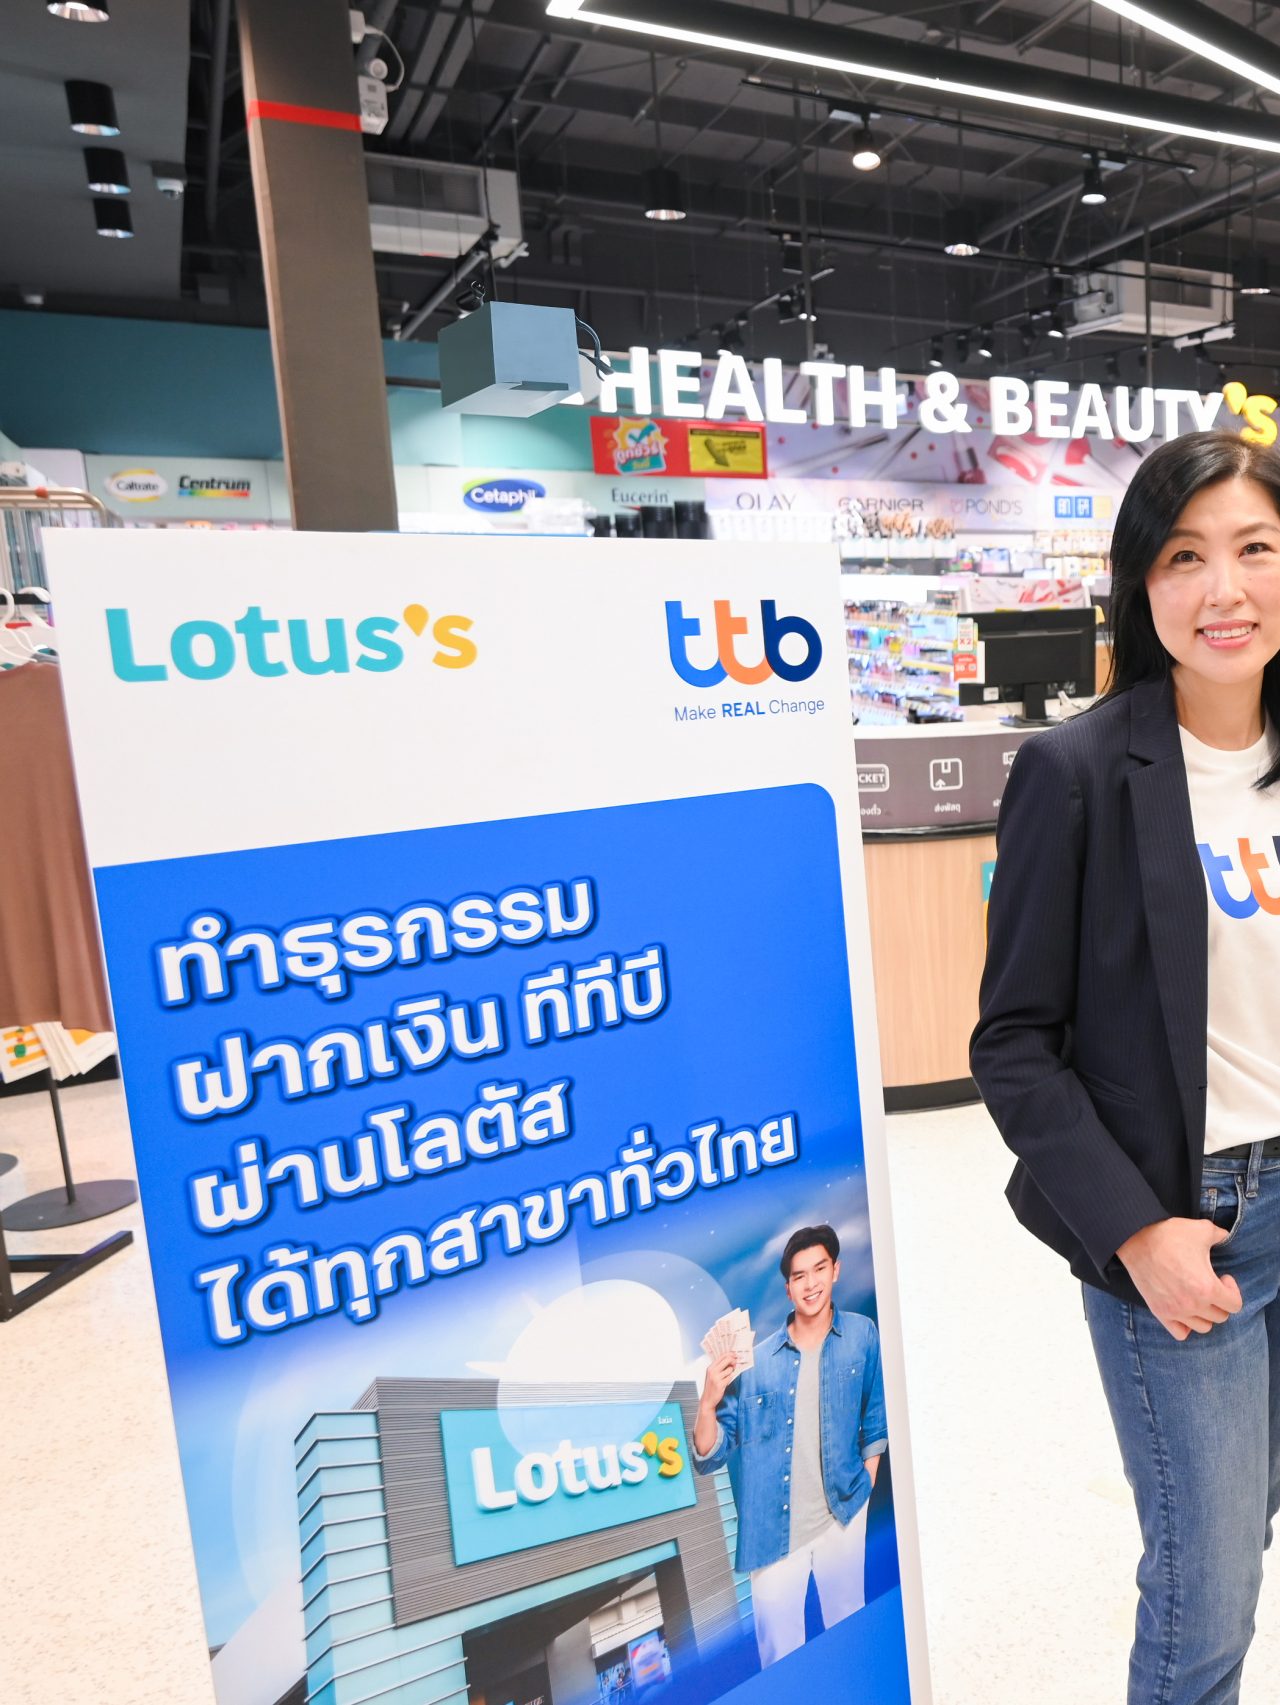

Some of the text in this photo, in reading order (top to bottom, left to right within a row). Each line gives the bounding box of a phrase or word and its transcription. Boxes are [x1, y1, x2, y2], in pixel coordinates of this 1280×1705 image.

[598, 346, 906, 430] HEALTH
[918, 371, 974, 434] &
[116, 480, 160, 491] Caltrate
[179, 475, 251, 491] Centrum
[611, 487, 669, 504] Eucerin
[736, 491, 797, 511] OLAY
[964, 499, 1023, 515] POND'S
[106, 604, 478, 682] Lotus's
[664, 599, 823, 688] ttb
[674, 698, 825, 721] Make REAL Change
[857, 773, 885, 784] CKET
[162, 883, 590, 1001] ทำธุรกรรม
[178, 949, 662, 1115] ฝากเงิน ทีทีบี
[194, 1083, 565, 1228] ผ่านโลตัส
[200, 1117, 795, 1338] ได้ทุกสาขาทั่วไทย
[471, 1431, 684, 1511] Lotus's
